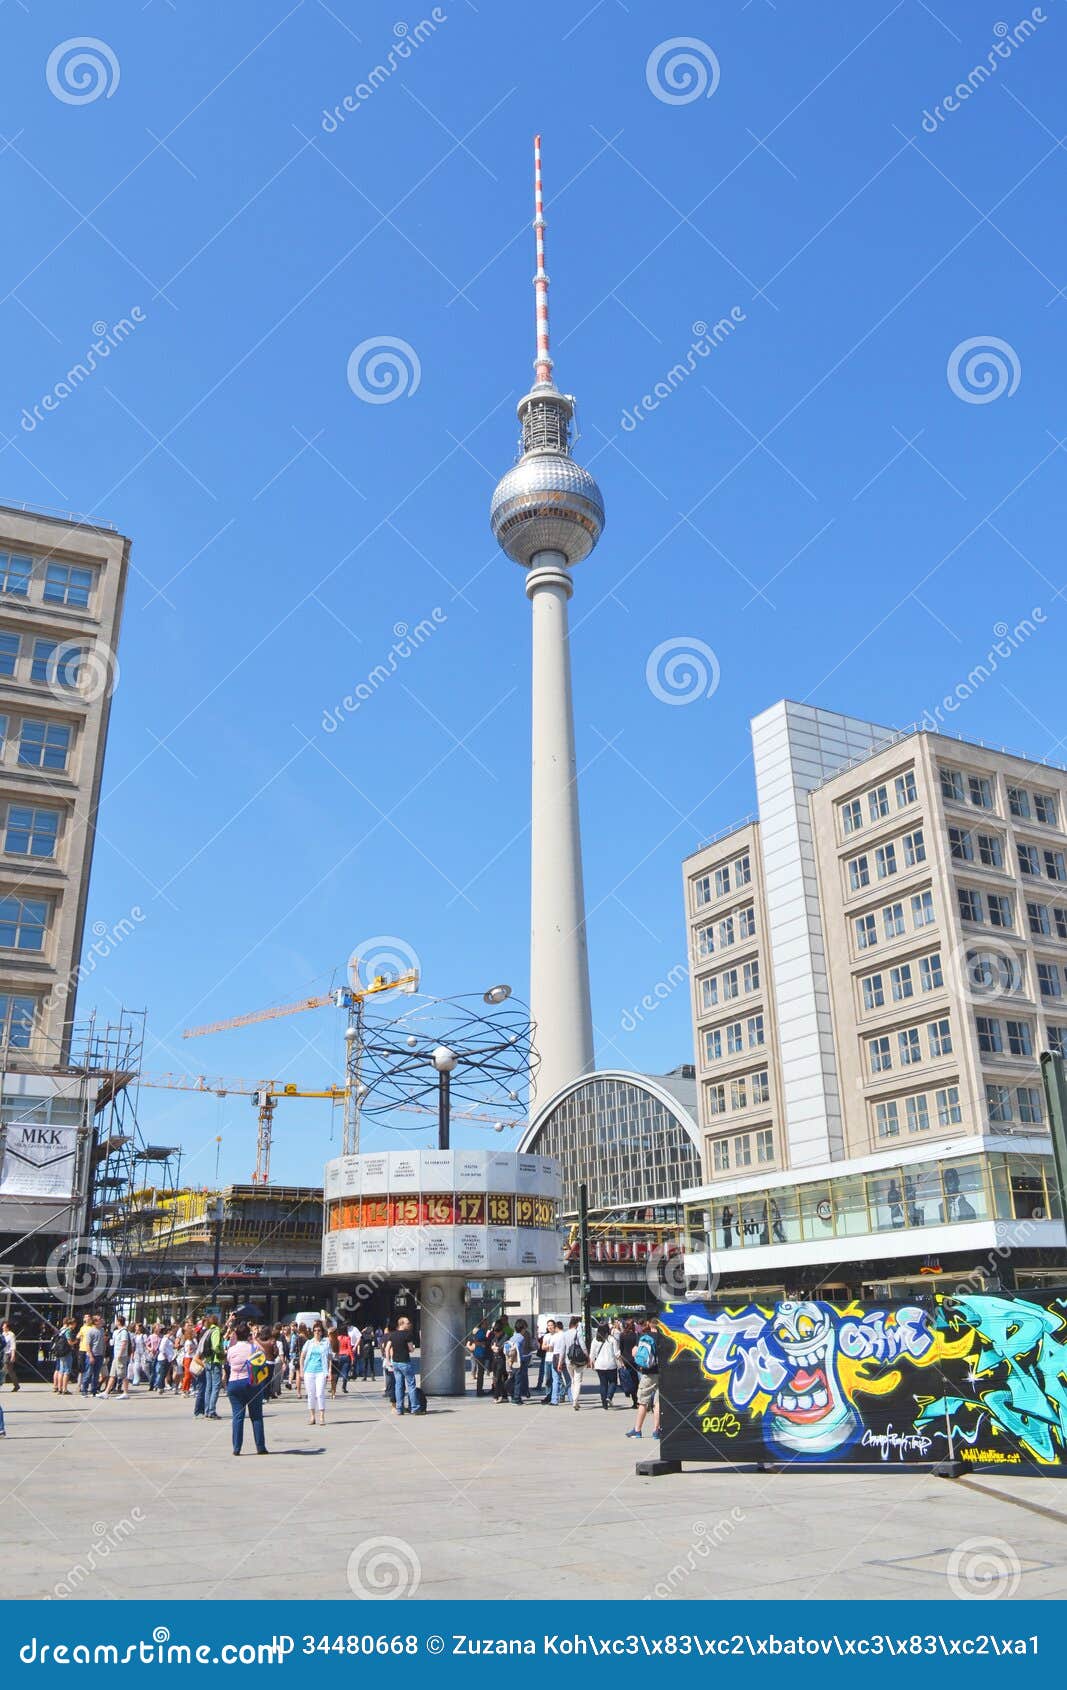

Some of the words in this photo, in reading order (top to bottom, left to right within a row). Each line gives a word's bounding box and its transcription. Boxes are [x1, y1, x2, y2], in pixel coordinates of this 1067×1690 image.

[21, 1128, 63, 1145] MKK
[368, 1202, 387, 1221] 14
[396, 1200, 418, 1220] 15
[427, 1199, 450, 1219] 16
[459, 1199, 481, 1218] 17
[489, 1200, 509, 1220] 18
[516, 1201, 532, 1220] 19
[535, 1203, 550, 1222] 20
[702, 1413, 741, 1437] 2013
